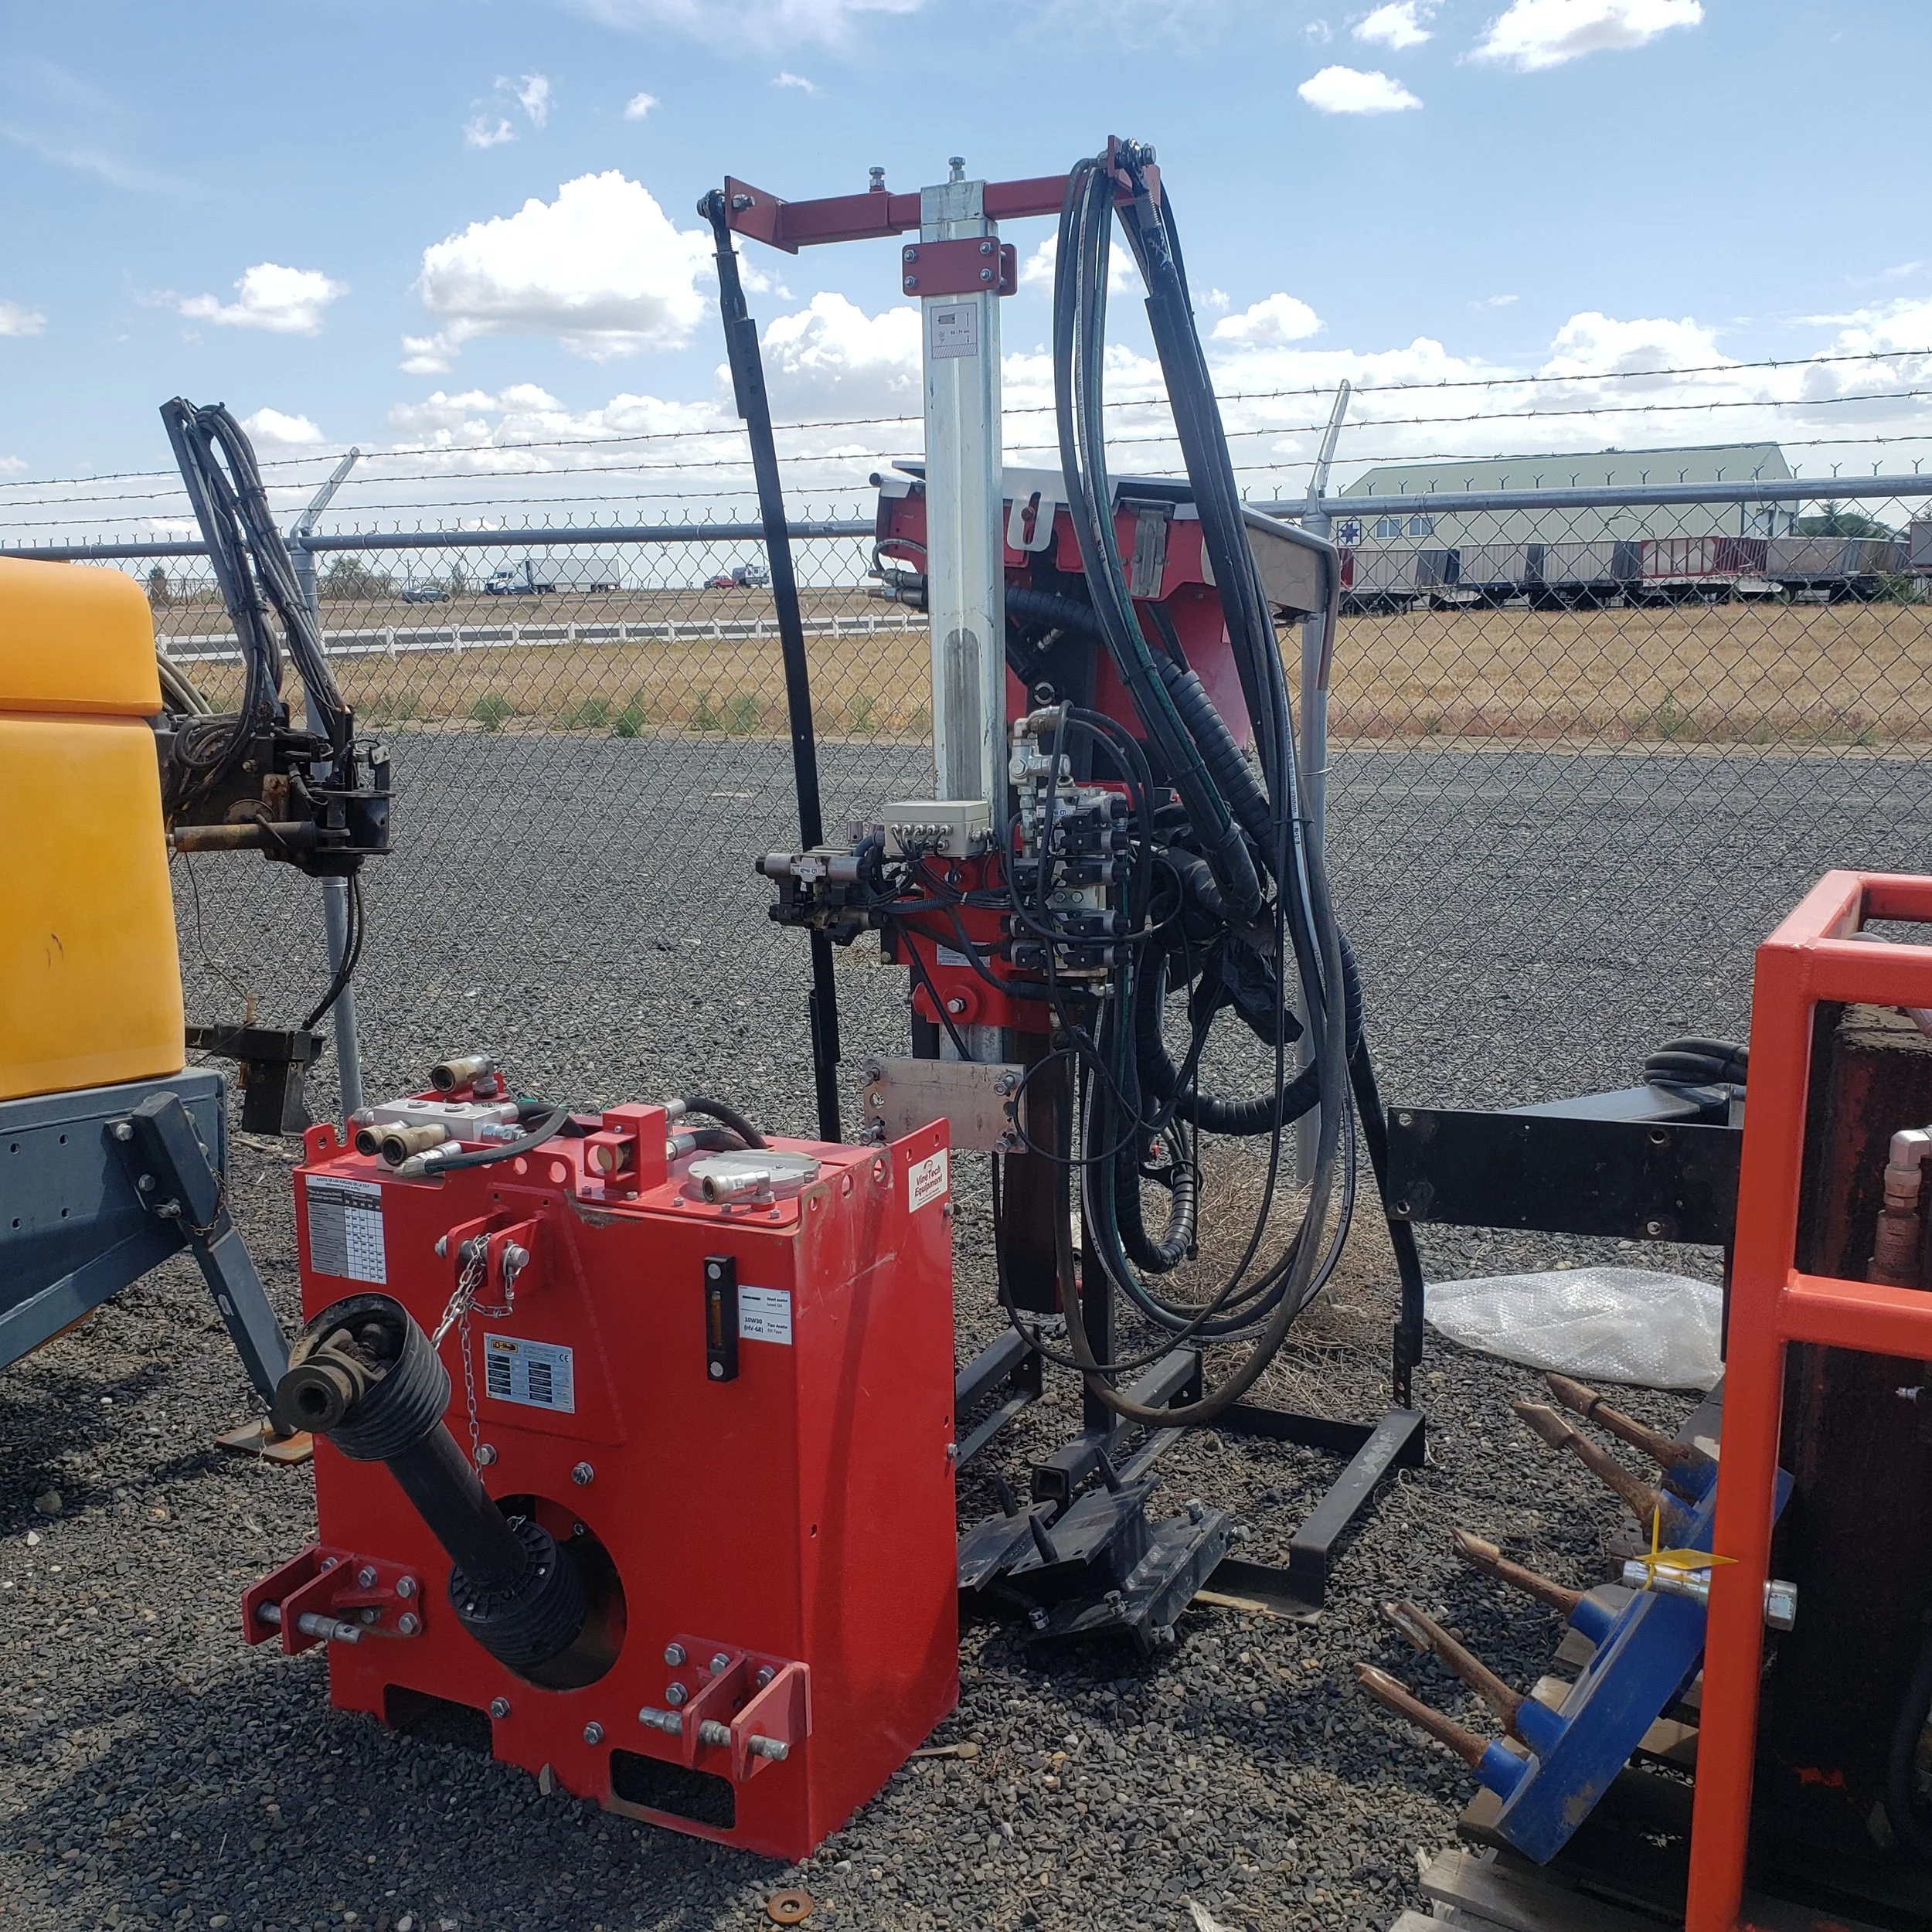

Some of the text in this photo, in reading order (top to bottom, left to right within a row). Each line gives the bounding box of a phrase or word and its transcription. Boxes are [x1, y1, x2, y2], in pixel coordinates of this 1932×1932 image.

[915, 1173, 942, 1197] Equipment
[744, 1316, 763, 1325] 10W30
[743, 1324, 764, 1334] (HV-68)
[559, 1354, 569, 1362] CE
